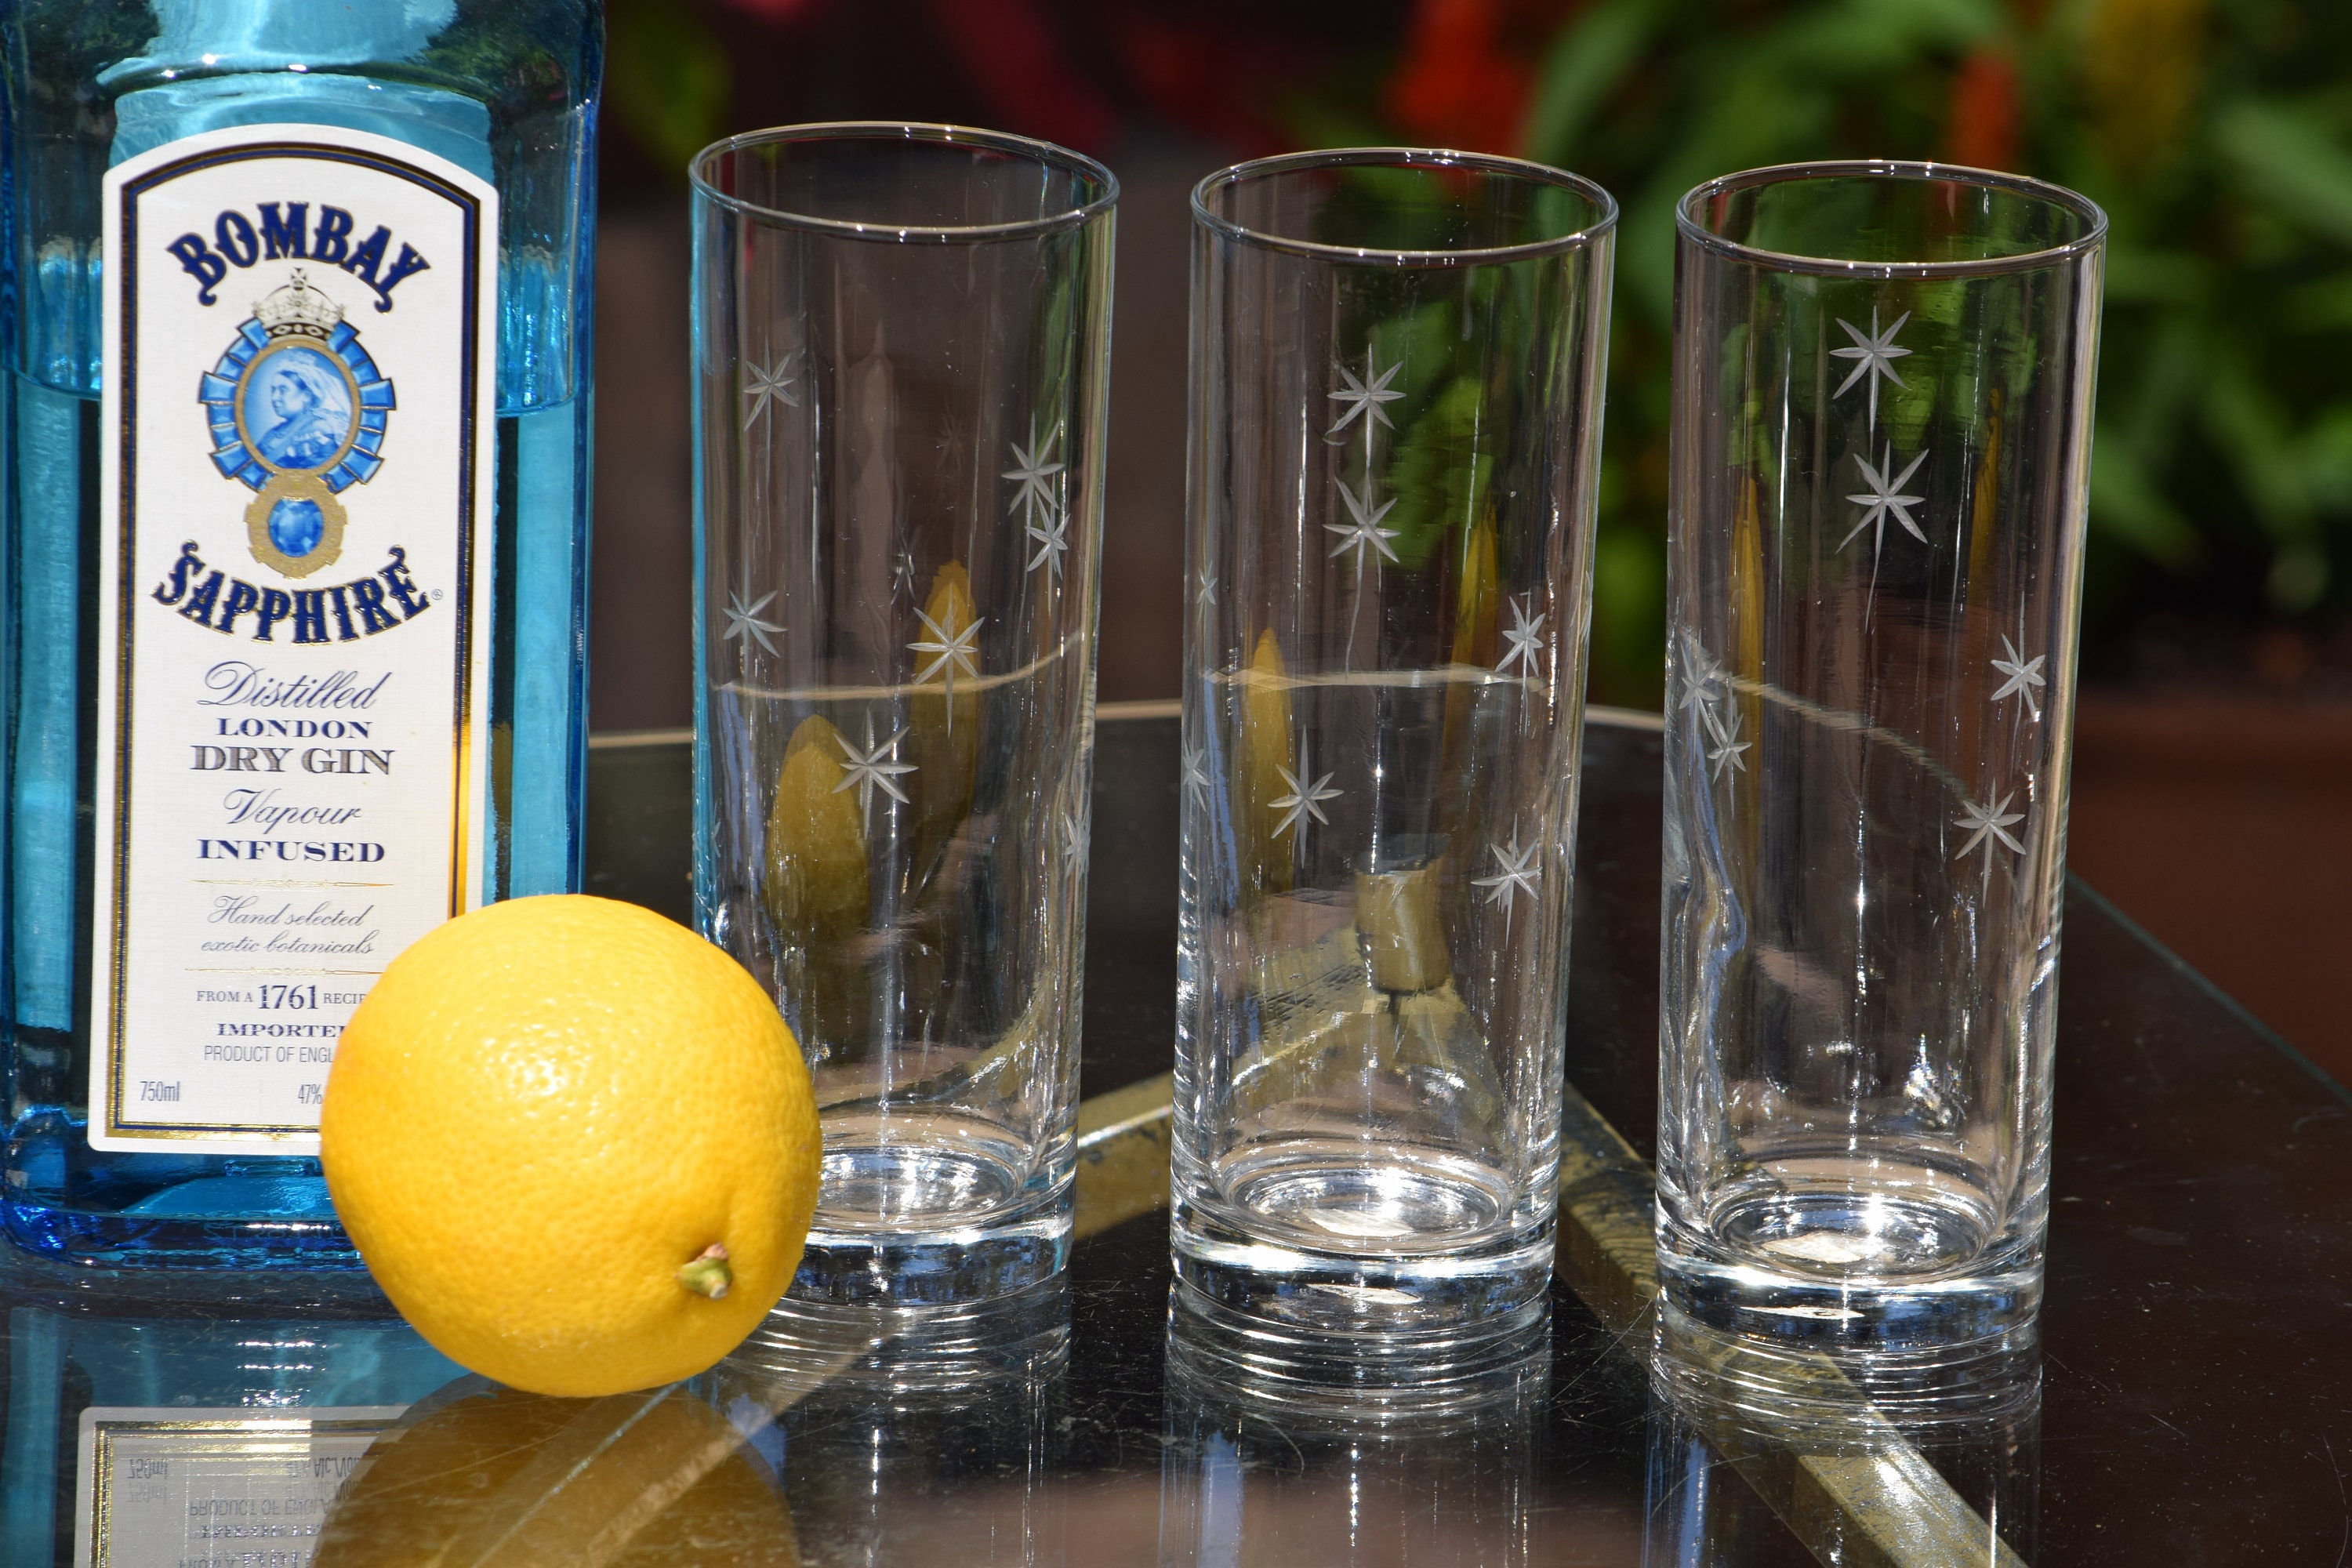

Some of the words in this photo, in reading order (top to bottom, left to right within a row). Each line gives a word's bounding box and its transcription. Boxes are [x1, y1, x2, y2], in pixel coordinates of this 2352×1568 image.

[167, 201, 430, 314] BOMBAY
[197, 661, 392, 709] Distilled
[216, 718, 372, 739] LONDON
[190, 746, 293, 771] DRY
[301, 748, 395, 775] GIN
[223, 788, 361, 834] Vapour
[196, 839, 385, 862] INFUSED
[207, 895, 291, 925] Hand
[284, 902, 374, 926] selected
[201, 936, 260, 953] exotic
[263, 930, 379, 954] botanicals
[196, 990, 240, 1002] FROM
[244, 992, 253, 1002] A
[258, 985, 319, 1010] 1761
[323, 993, 367, 1004] RECIP
[204, 1045, 272, 1062] PRODUCT
[276, 1047, 295, 1062] OF
[299, 1047, 333, 1062] ENGL
[140, 1081, 180, 1102] 750ml
[297, 1083, 323, 1105] 47%
